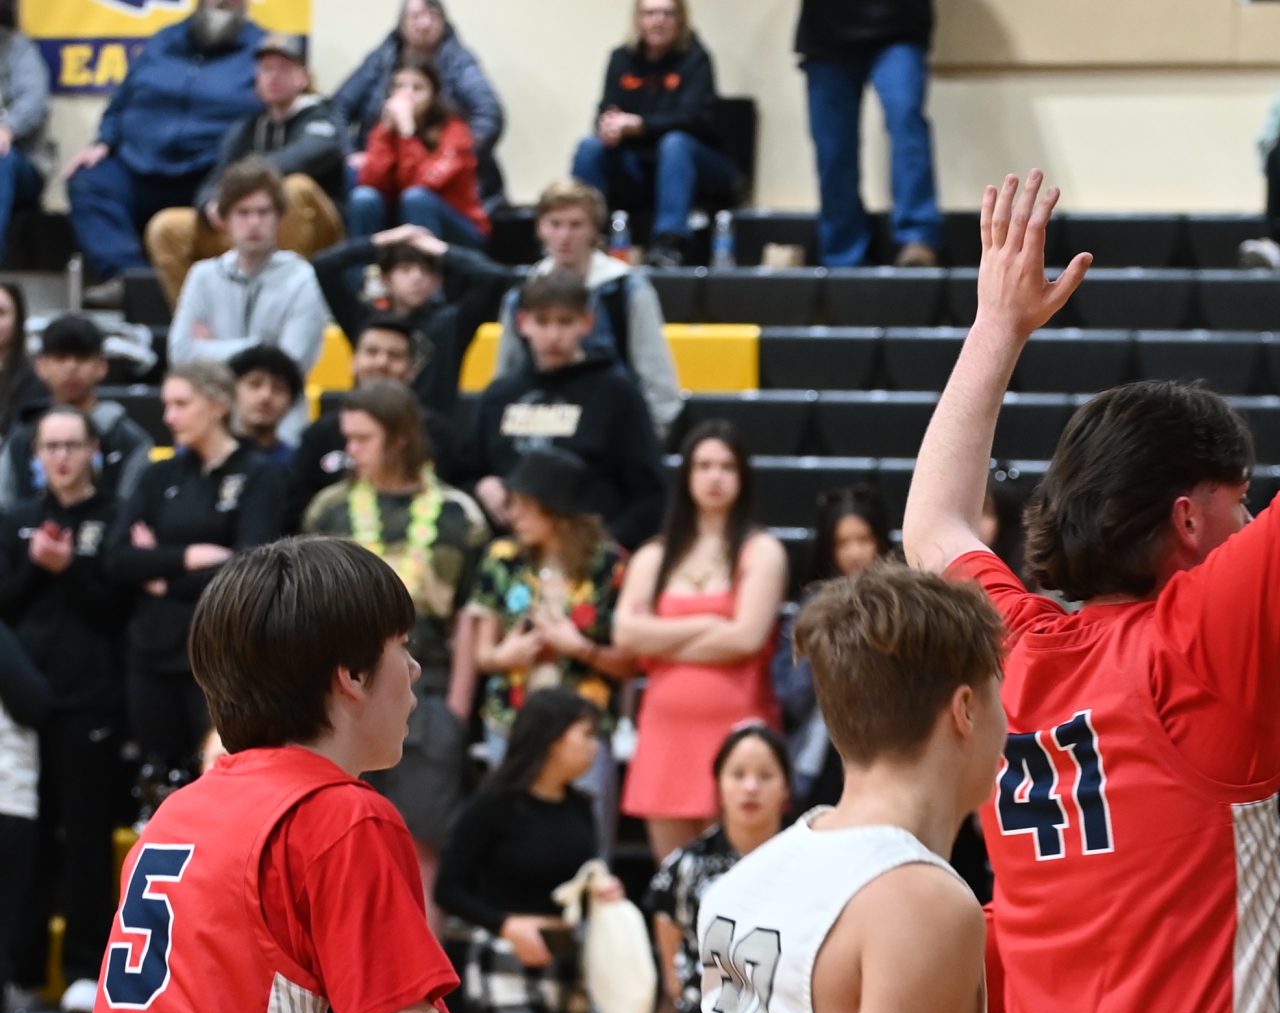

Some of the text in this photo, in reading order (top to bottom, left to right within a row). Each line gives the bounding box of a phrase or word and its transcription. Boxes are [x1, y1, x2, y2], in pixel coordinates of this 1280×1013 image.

[59, 43, 132, 87] EA
[994, 709, 1115, 861] 41
[103, 843, 195, 1010] 5
